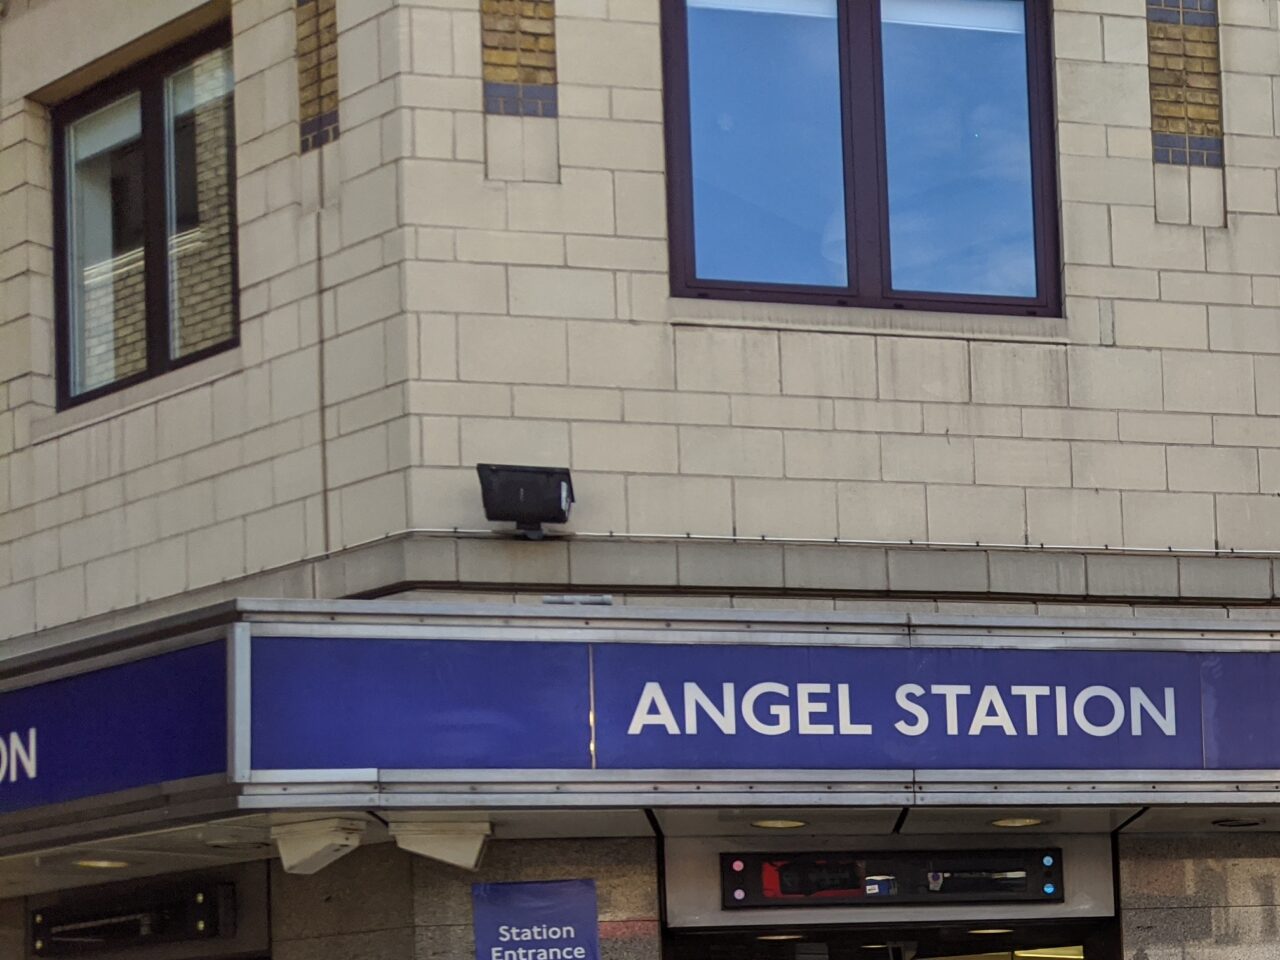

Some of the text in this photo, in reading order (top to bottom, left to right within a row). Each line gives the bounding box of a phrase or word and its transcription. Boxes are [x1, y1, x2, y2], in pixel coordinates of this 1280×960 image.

[627, 681, 1176, 736] ANGEL STATION
[498, 924, 575, 942] Station
